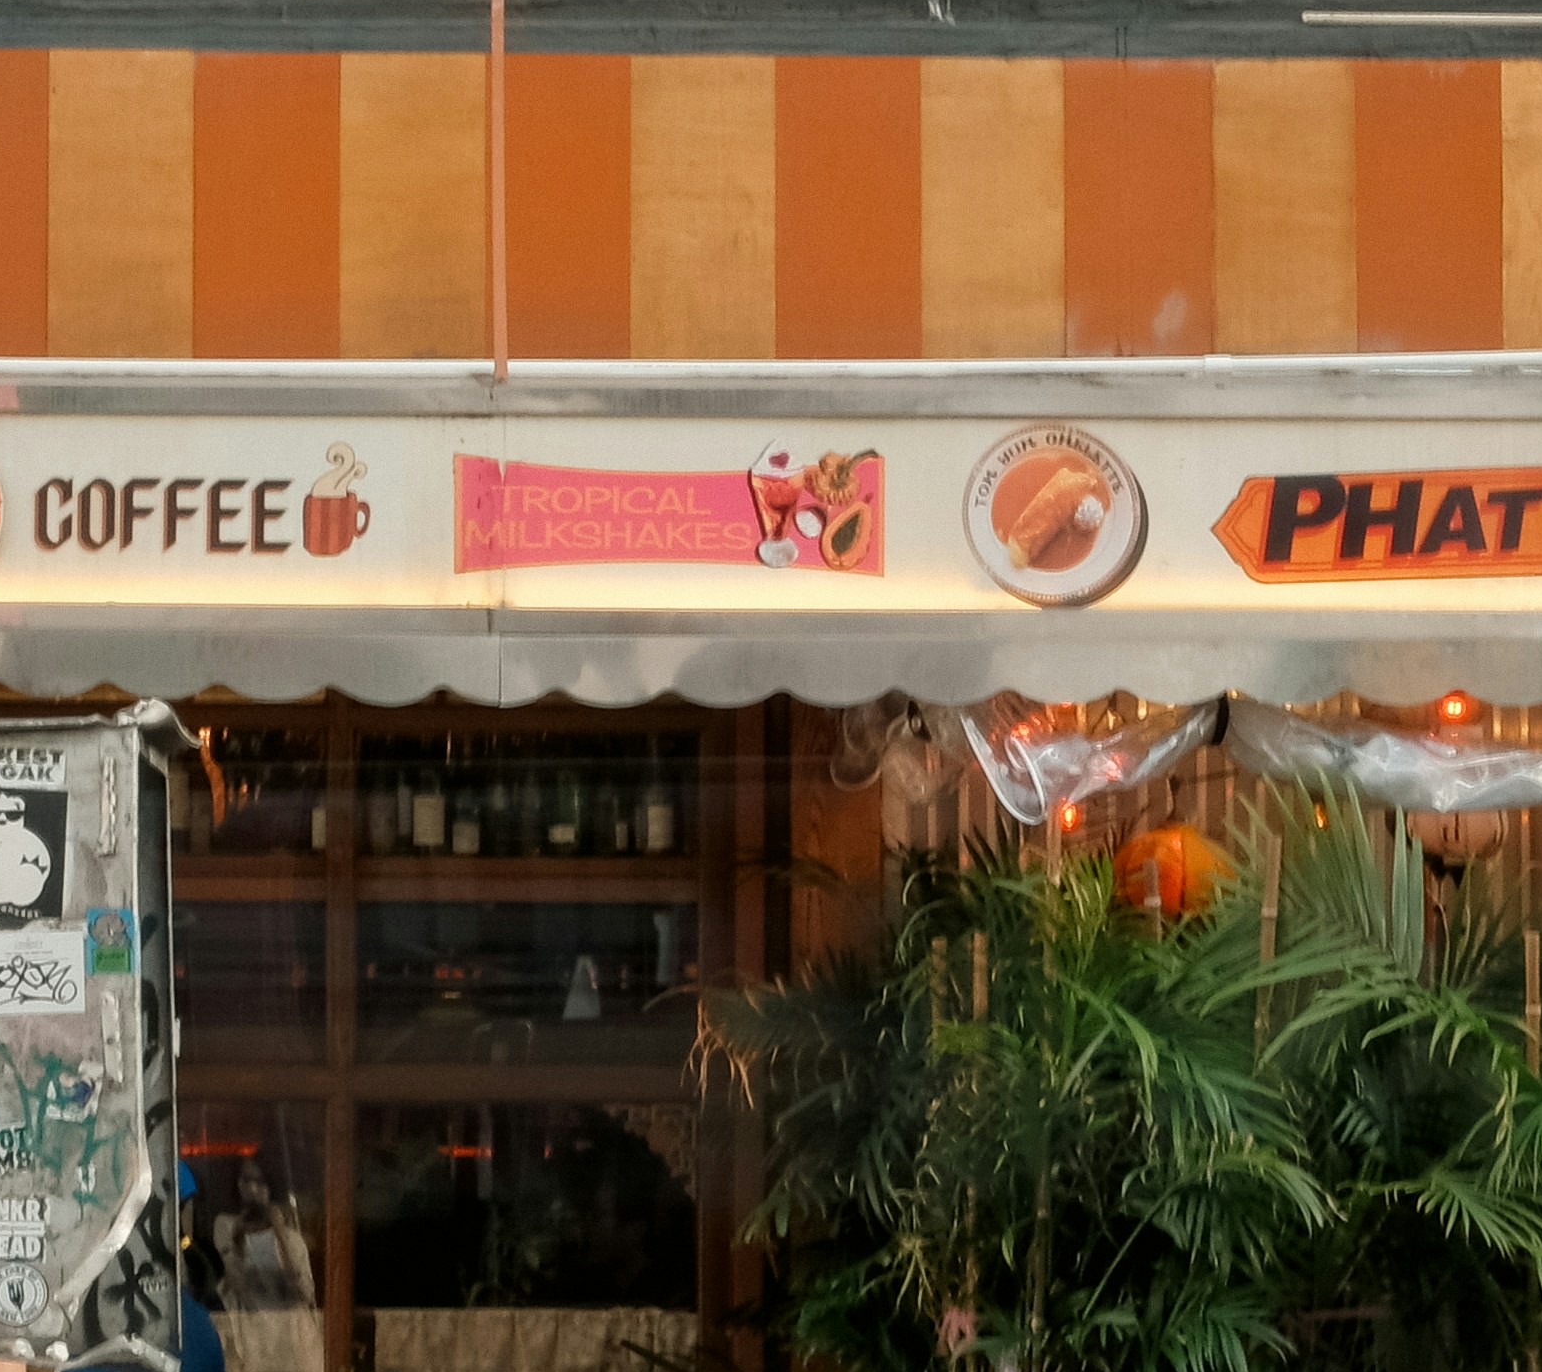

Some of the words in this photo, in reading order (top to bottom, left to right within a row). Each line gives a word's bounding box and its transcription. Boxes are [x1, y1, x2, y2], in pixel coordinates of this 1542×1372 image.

[33, 477, 292, 554] COFFEE
[494, 484, 711, 516] TROPICAL
[465, 517, 755, 551] MILKSHAKES
